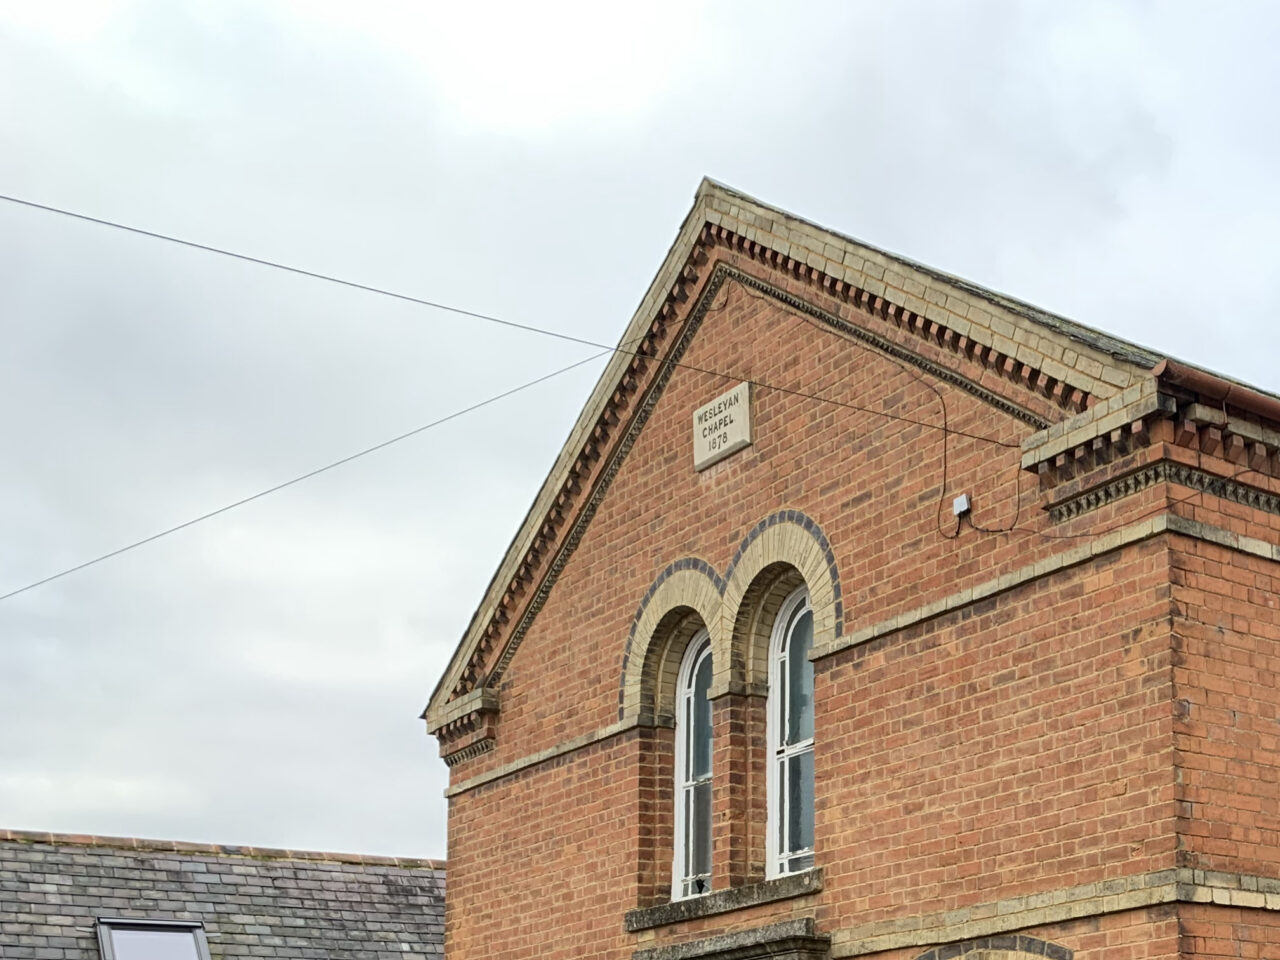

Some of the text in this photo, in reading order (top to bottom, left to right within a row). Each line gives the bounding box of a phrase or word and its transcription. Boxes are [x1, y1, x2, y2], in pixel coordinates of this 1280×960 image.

[698, 392, 739, 425] WESLEYAN
[702, 414, 734, 438] CHAPEL
[709, 432, 728, 451] 1878
